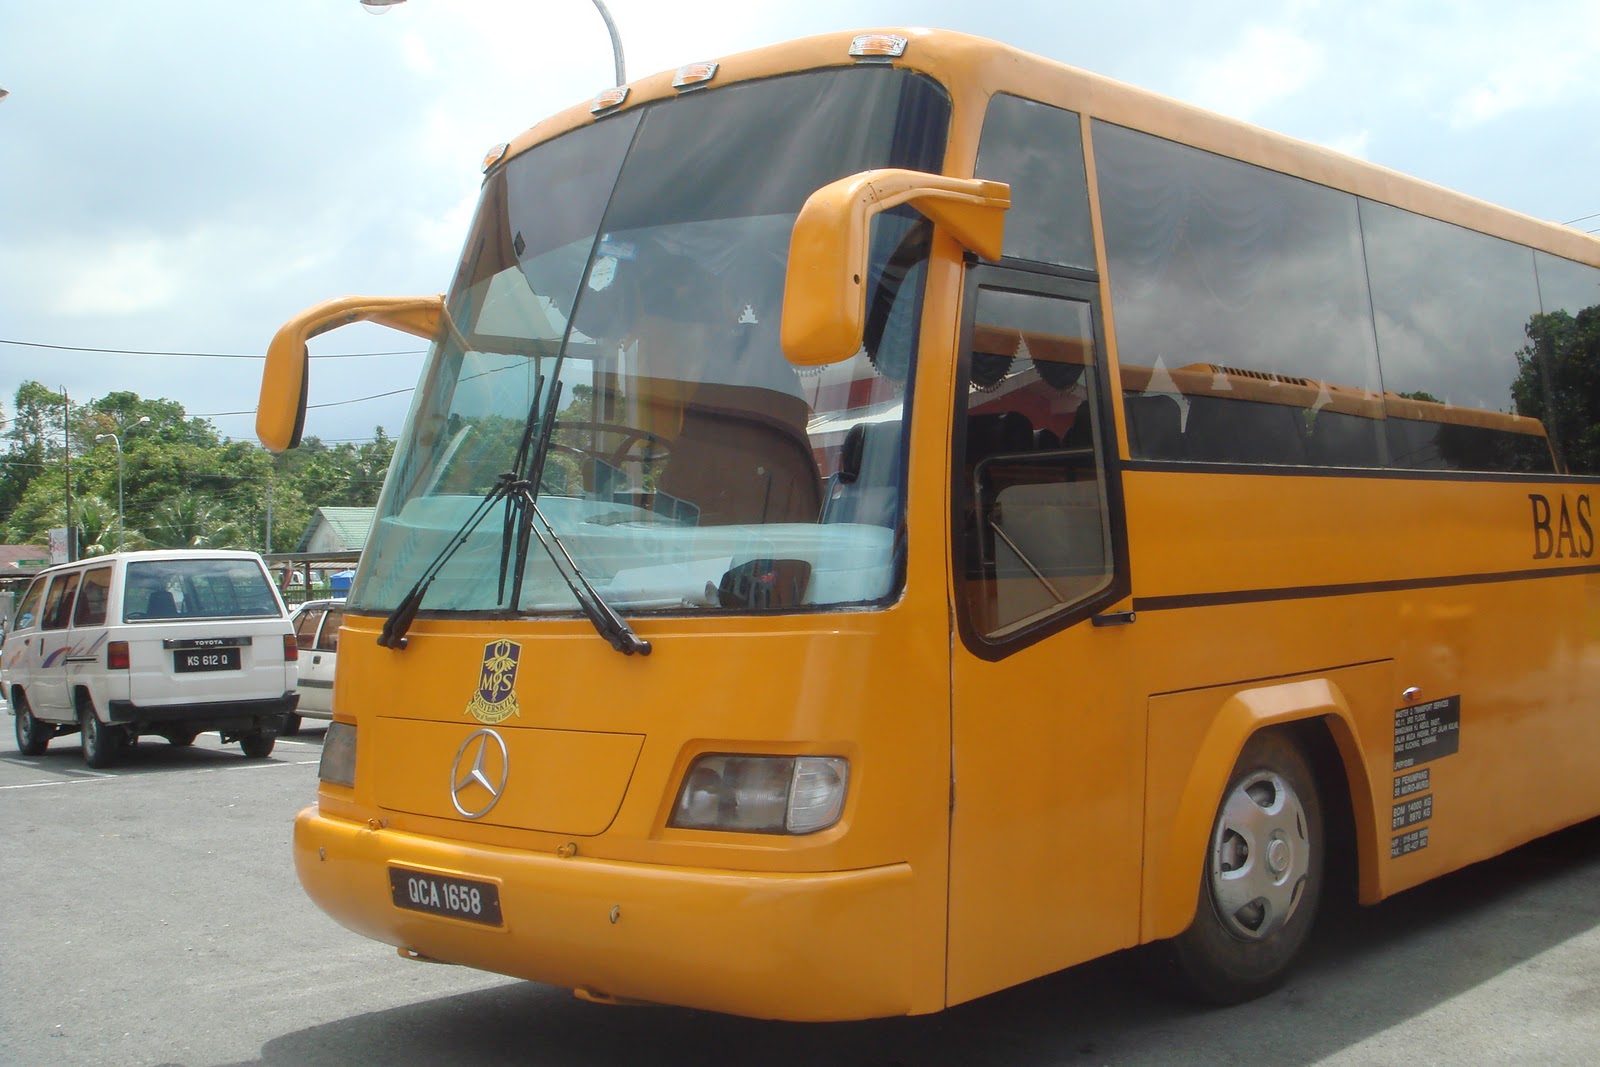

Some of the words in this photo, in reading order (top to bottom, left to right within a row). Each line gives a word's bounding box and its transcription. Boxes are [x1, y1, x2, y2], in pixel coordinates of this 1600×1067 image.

[1528, 494, 1594, 560] BAS
[188, 656, 199, 666] KS
[202, 655, 218, 665] 612
[222, 654, 228, 664] Q
[480, 674, 493, 690] M
[500, 674, 512, 691] S
[1424, 797, 1431, 807] KG
[1423, 807, 1430, 817] KG
[408, 878, 440, 908] QCA
[443, 883, 481, 914] 1658
